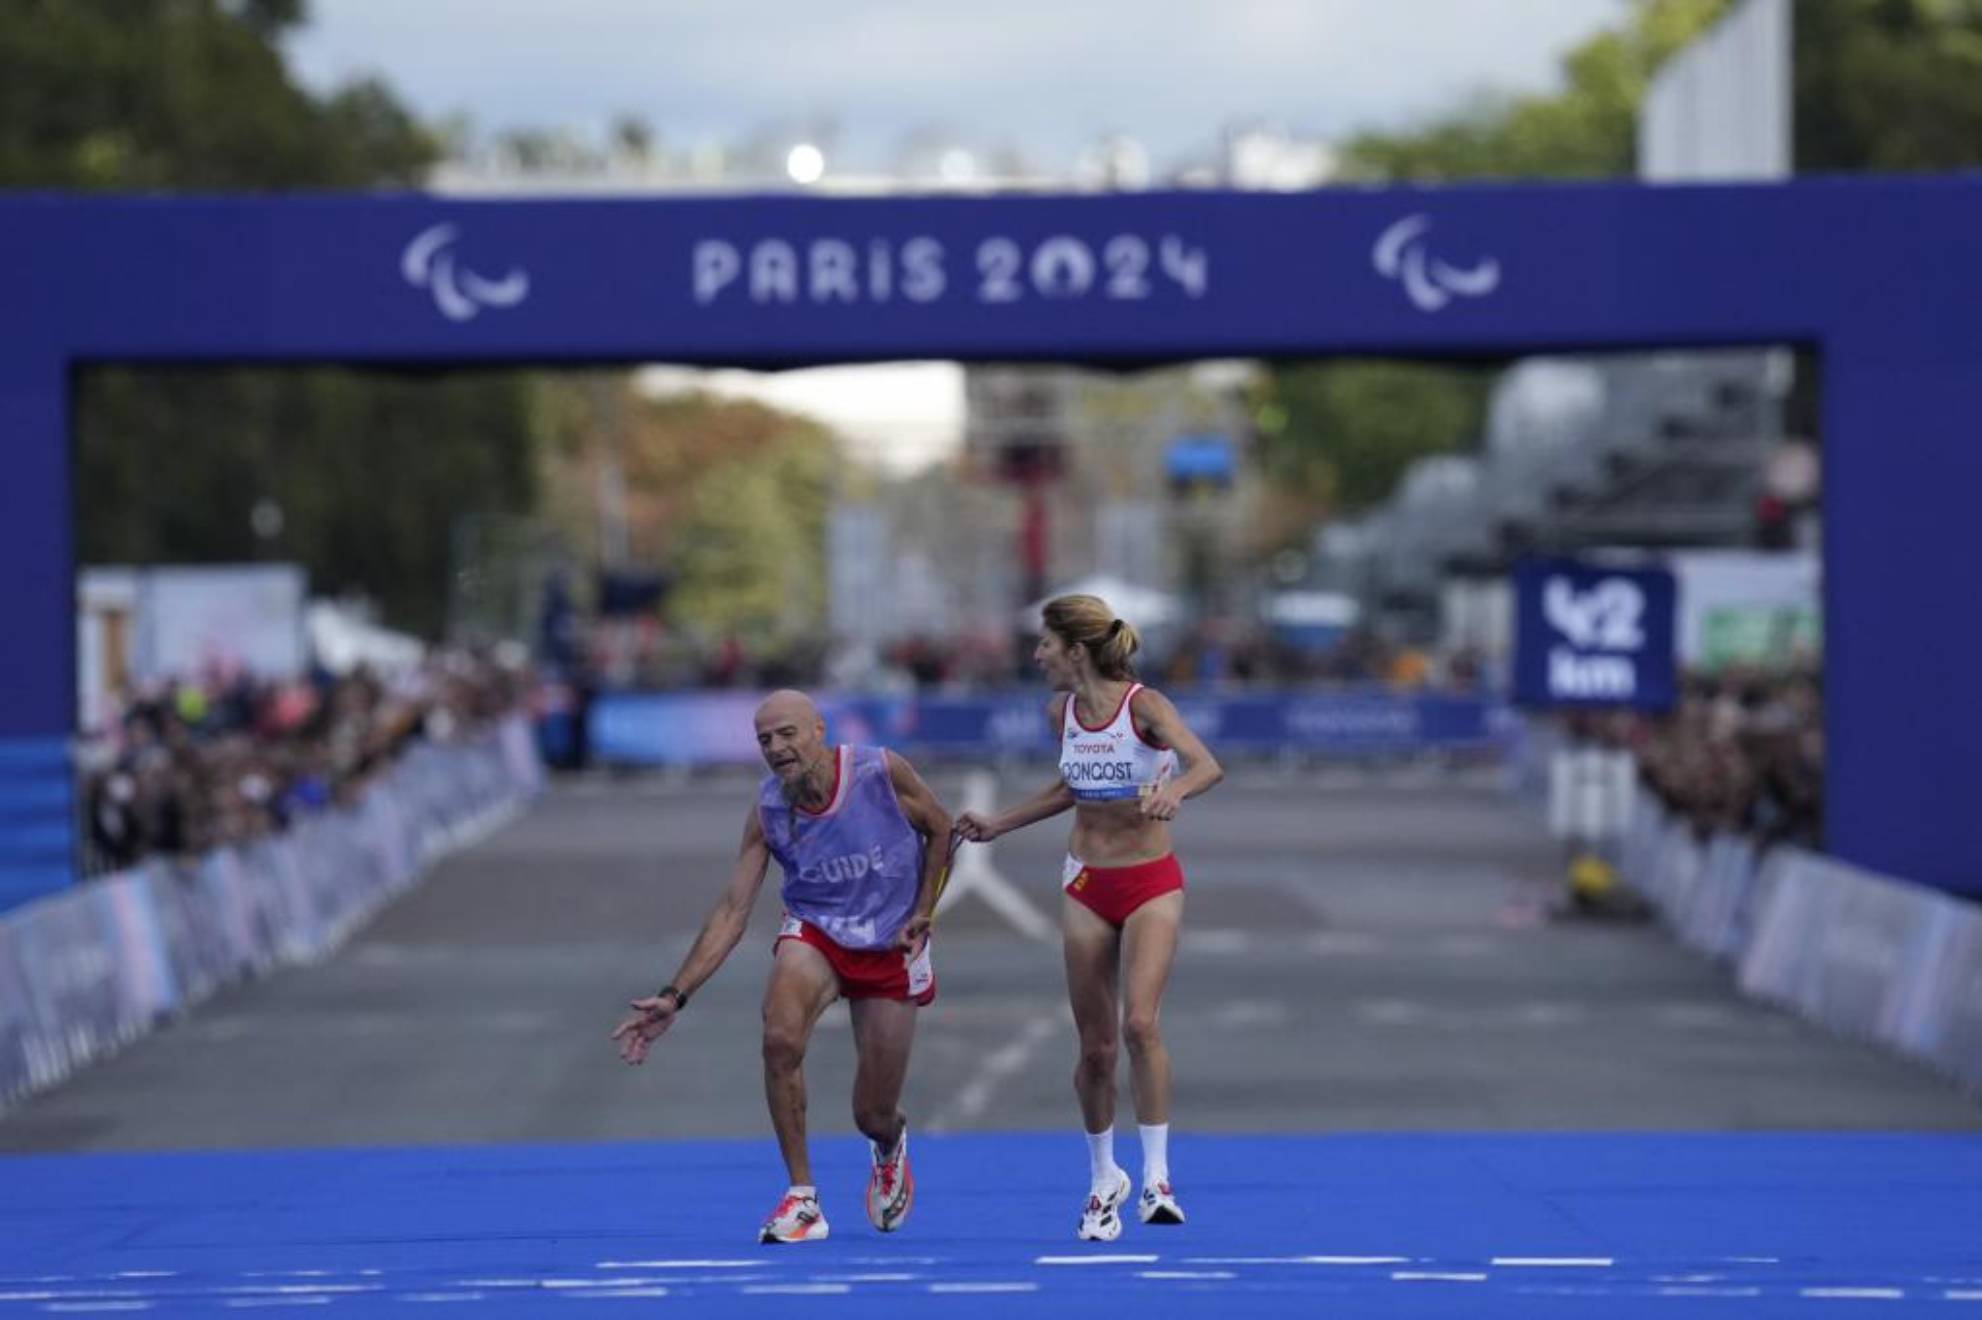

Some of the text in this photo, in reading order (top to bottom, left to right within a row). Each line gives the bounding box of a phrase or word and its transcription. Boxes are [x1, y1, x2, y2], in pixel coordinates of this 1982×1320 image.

[975, 234, 1207, 302] 2024
[1543, 575, 1646, 649] 42
[1548, 648, 1636, 698] km
[1073, 744, 1115, 753] TOYOTA
[799, 845, 884, 883] GUIDE
